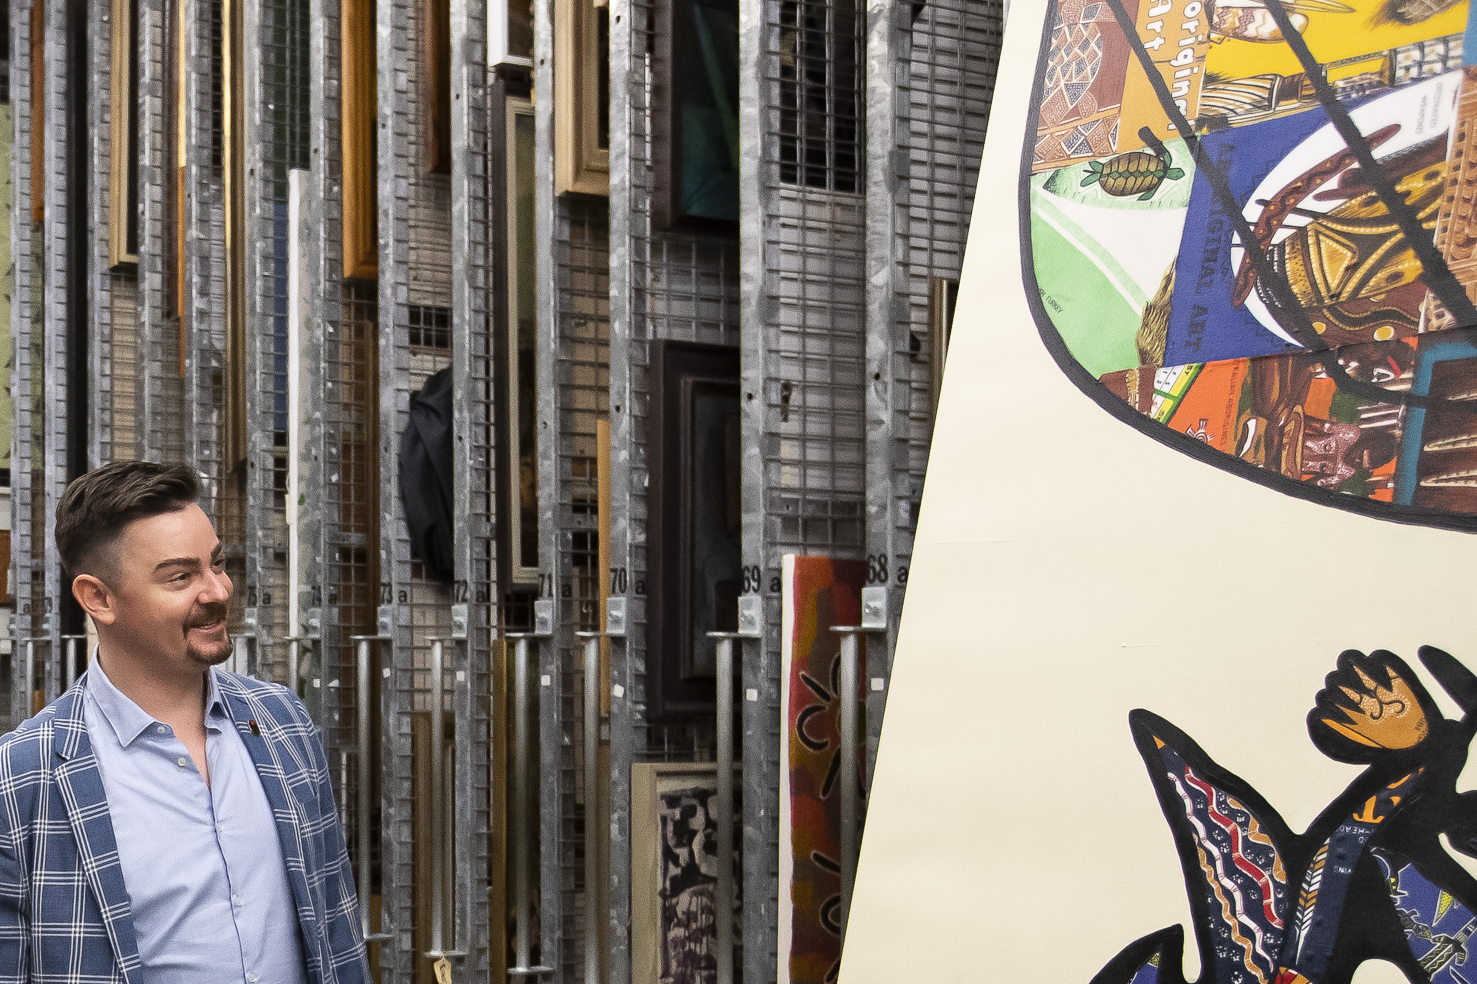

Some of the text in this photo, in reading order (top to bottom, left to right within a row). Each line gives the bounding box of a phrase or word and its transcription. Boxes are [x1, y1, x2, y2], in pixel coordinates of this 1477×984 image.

[1185, 303, 1209, 351] ART
[610, 568, 645, 595] 70 a
[742, 565, 781, 593] 69 a
[867, 553, 908, 583] 68 a
[380, 582, 407, 603] 73 a
[454, 579, 468, 603] 72
[537, 573, 572, 598] 71 a
